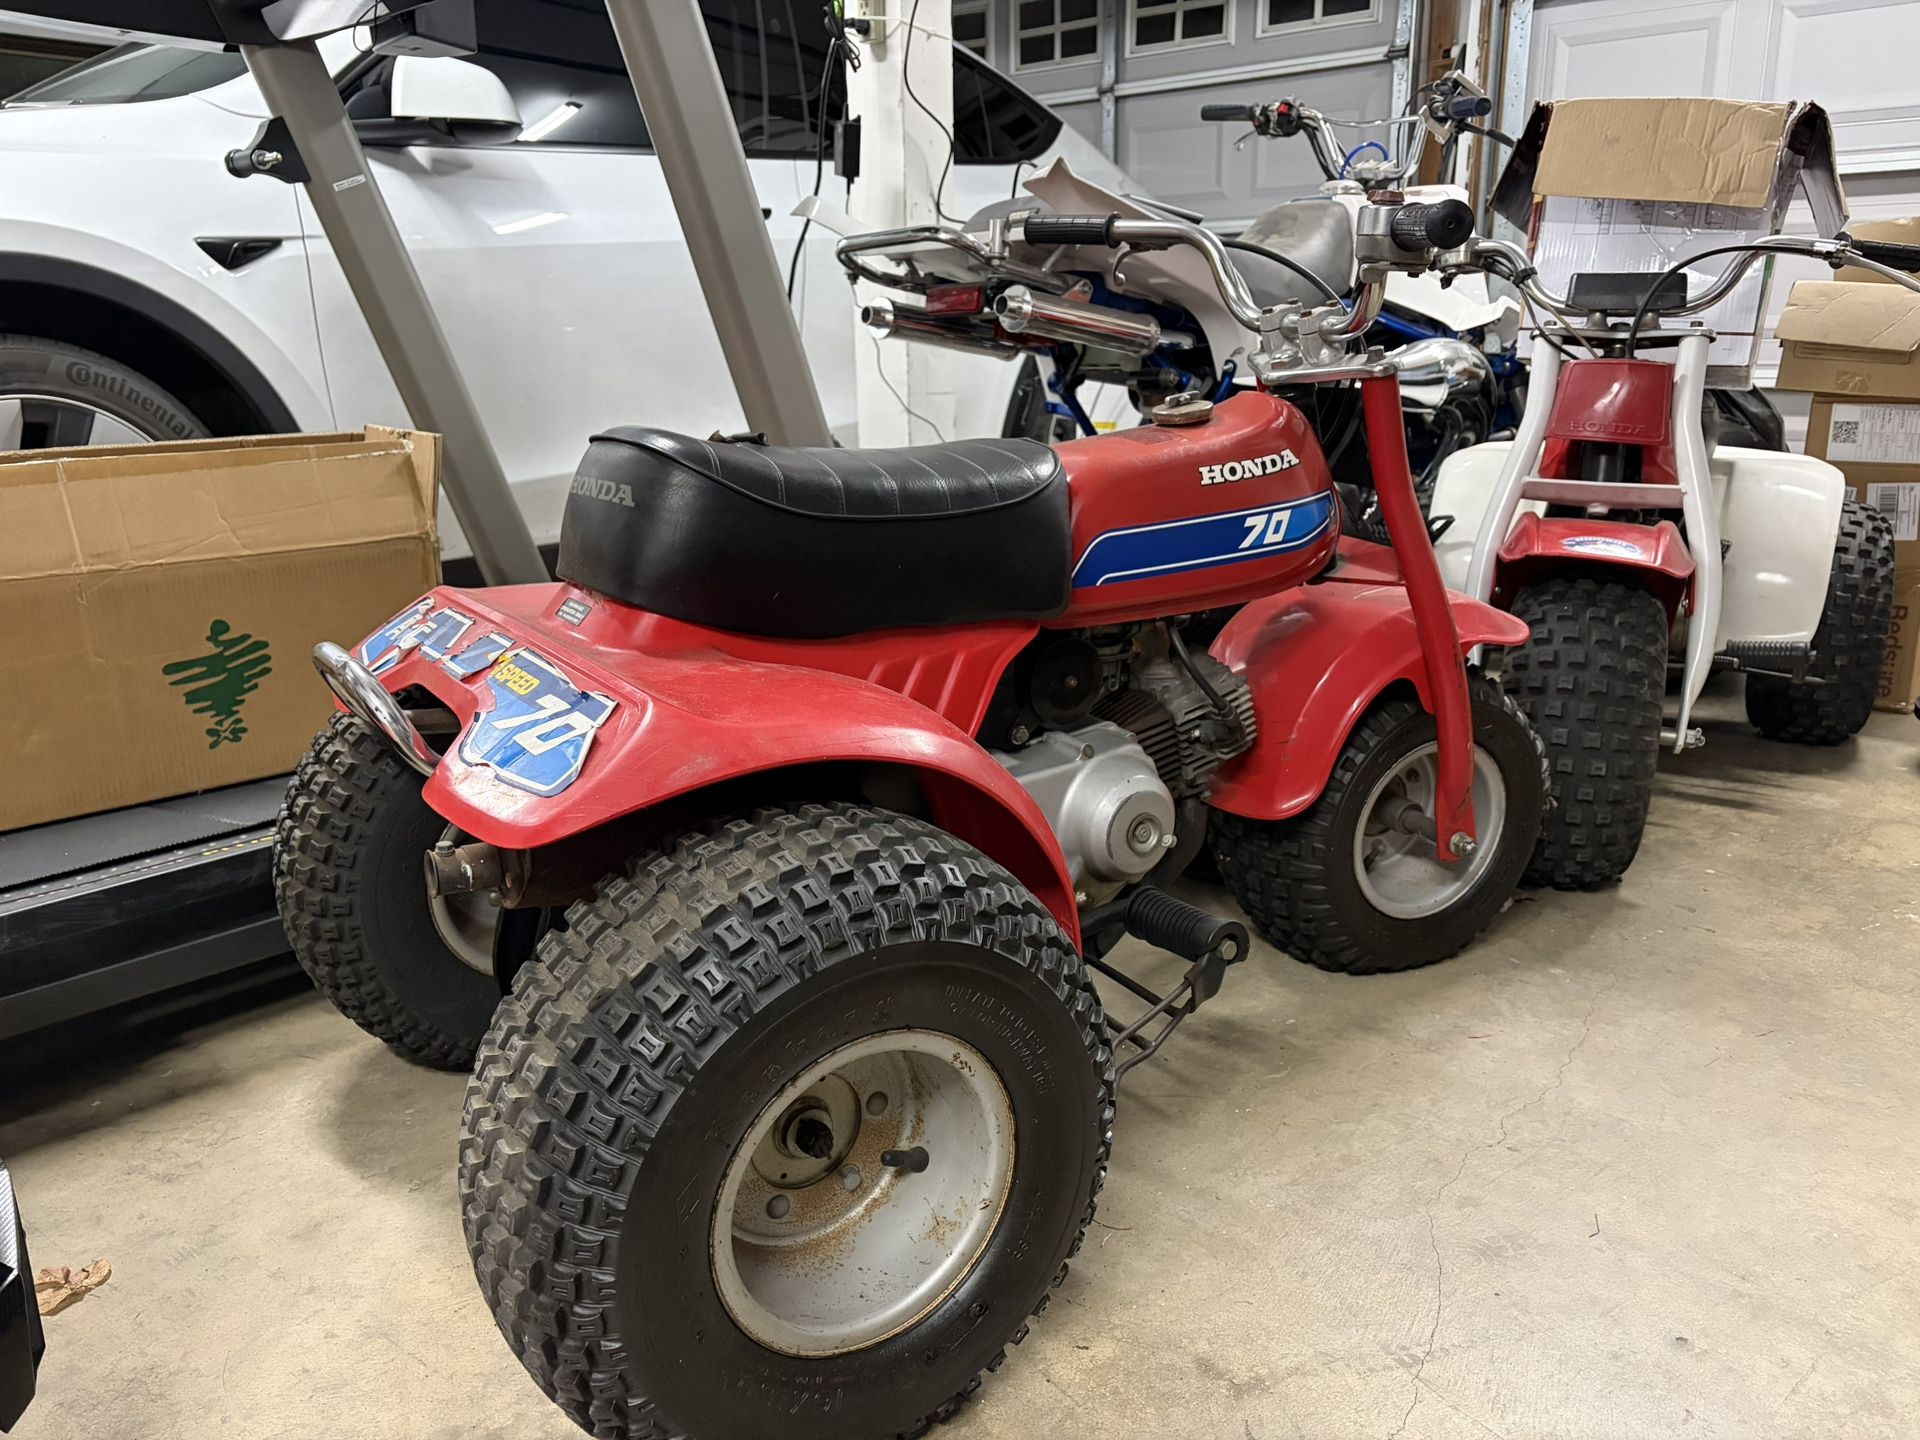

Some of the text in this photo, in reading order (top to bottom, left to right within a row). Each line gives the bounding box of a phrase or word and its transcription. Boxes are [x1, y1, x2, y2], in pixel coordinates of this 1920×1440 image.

[65, 361, 195, 439] Continental
[1569, 421, 1650, 434] HONDA
[1198, 448, 1300, 486] HONDA
[570, 476, 636, 508] HONDA
[1238, 509, 1292, 549] 70
[494, 663, 541, 696] SPEED
[490, 693, 594, 756] 70
